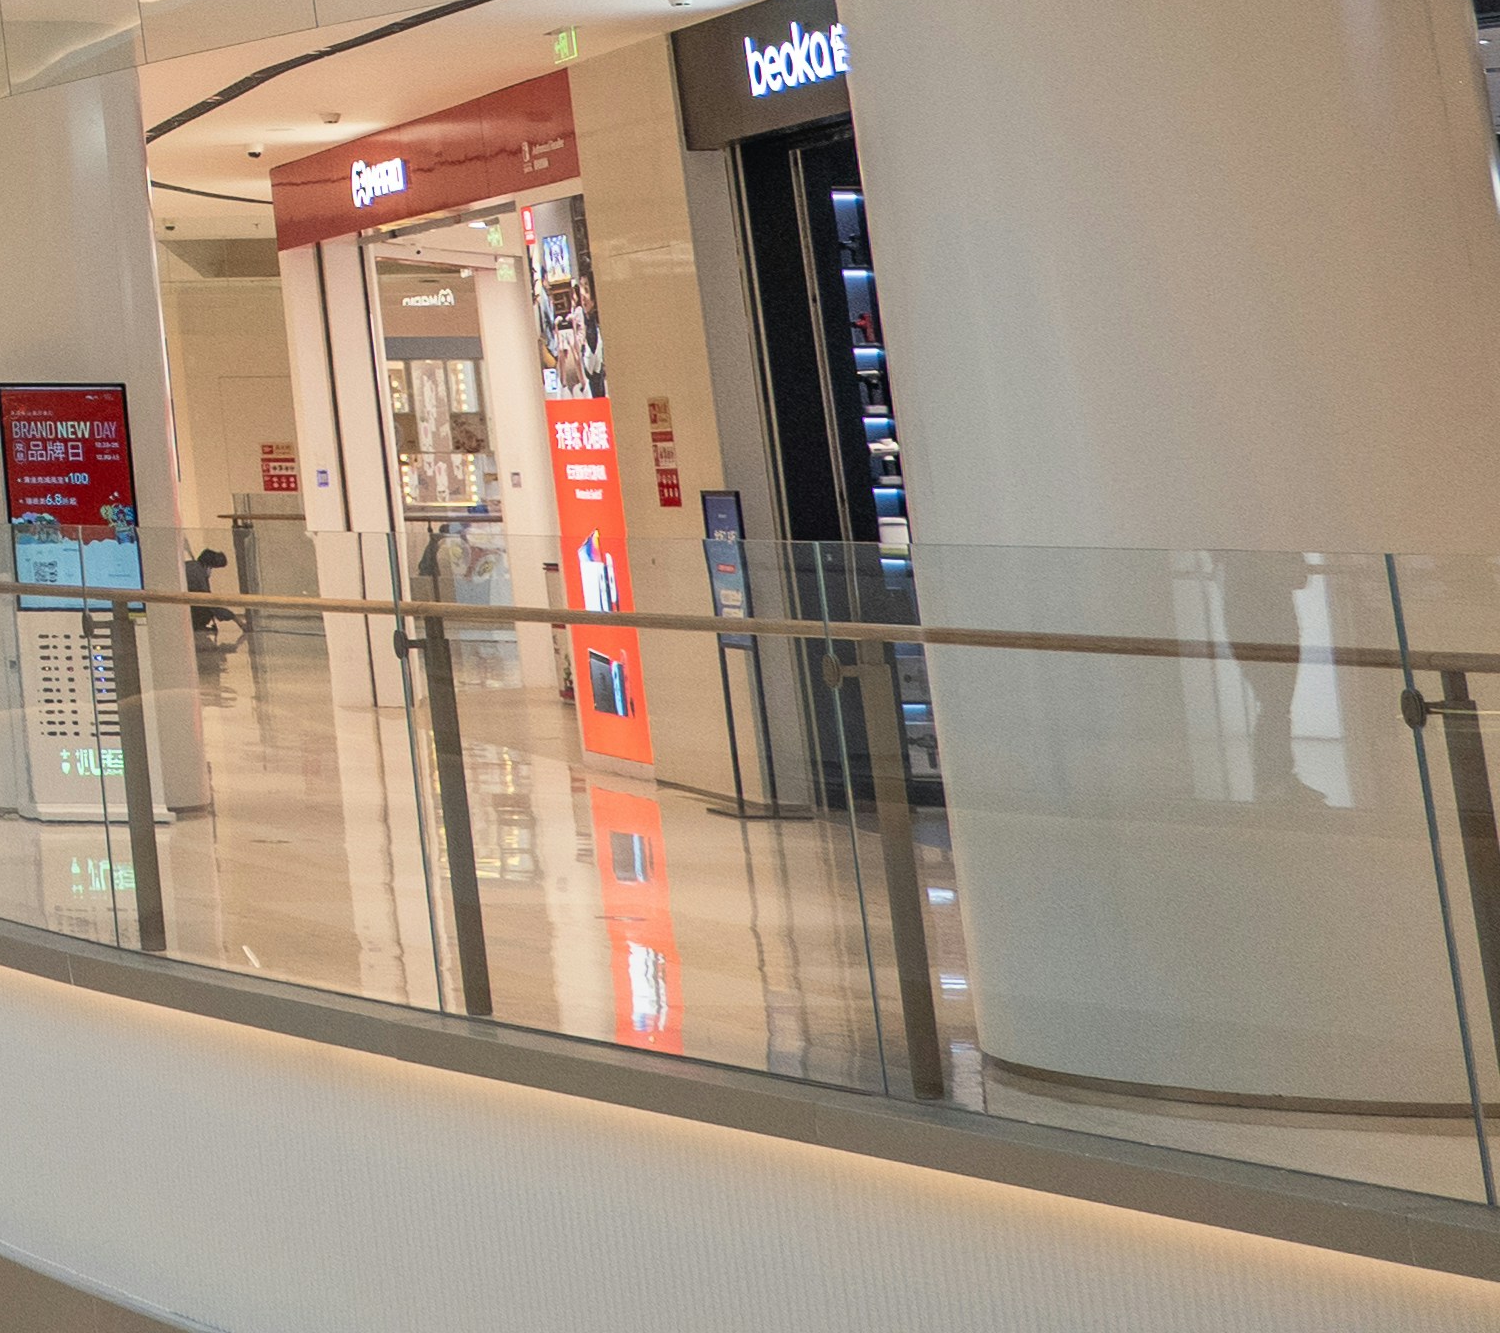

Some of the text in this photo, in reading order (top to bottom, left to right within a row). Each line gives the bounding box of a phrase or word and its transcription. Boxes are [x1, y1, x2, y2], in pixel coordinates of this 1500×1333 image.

[11, 421, 117, 439] BRAND NEW DAY
[28, 441, 84, 462] 品牌日
